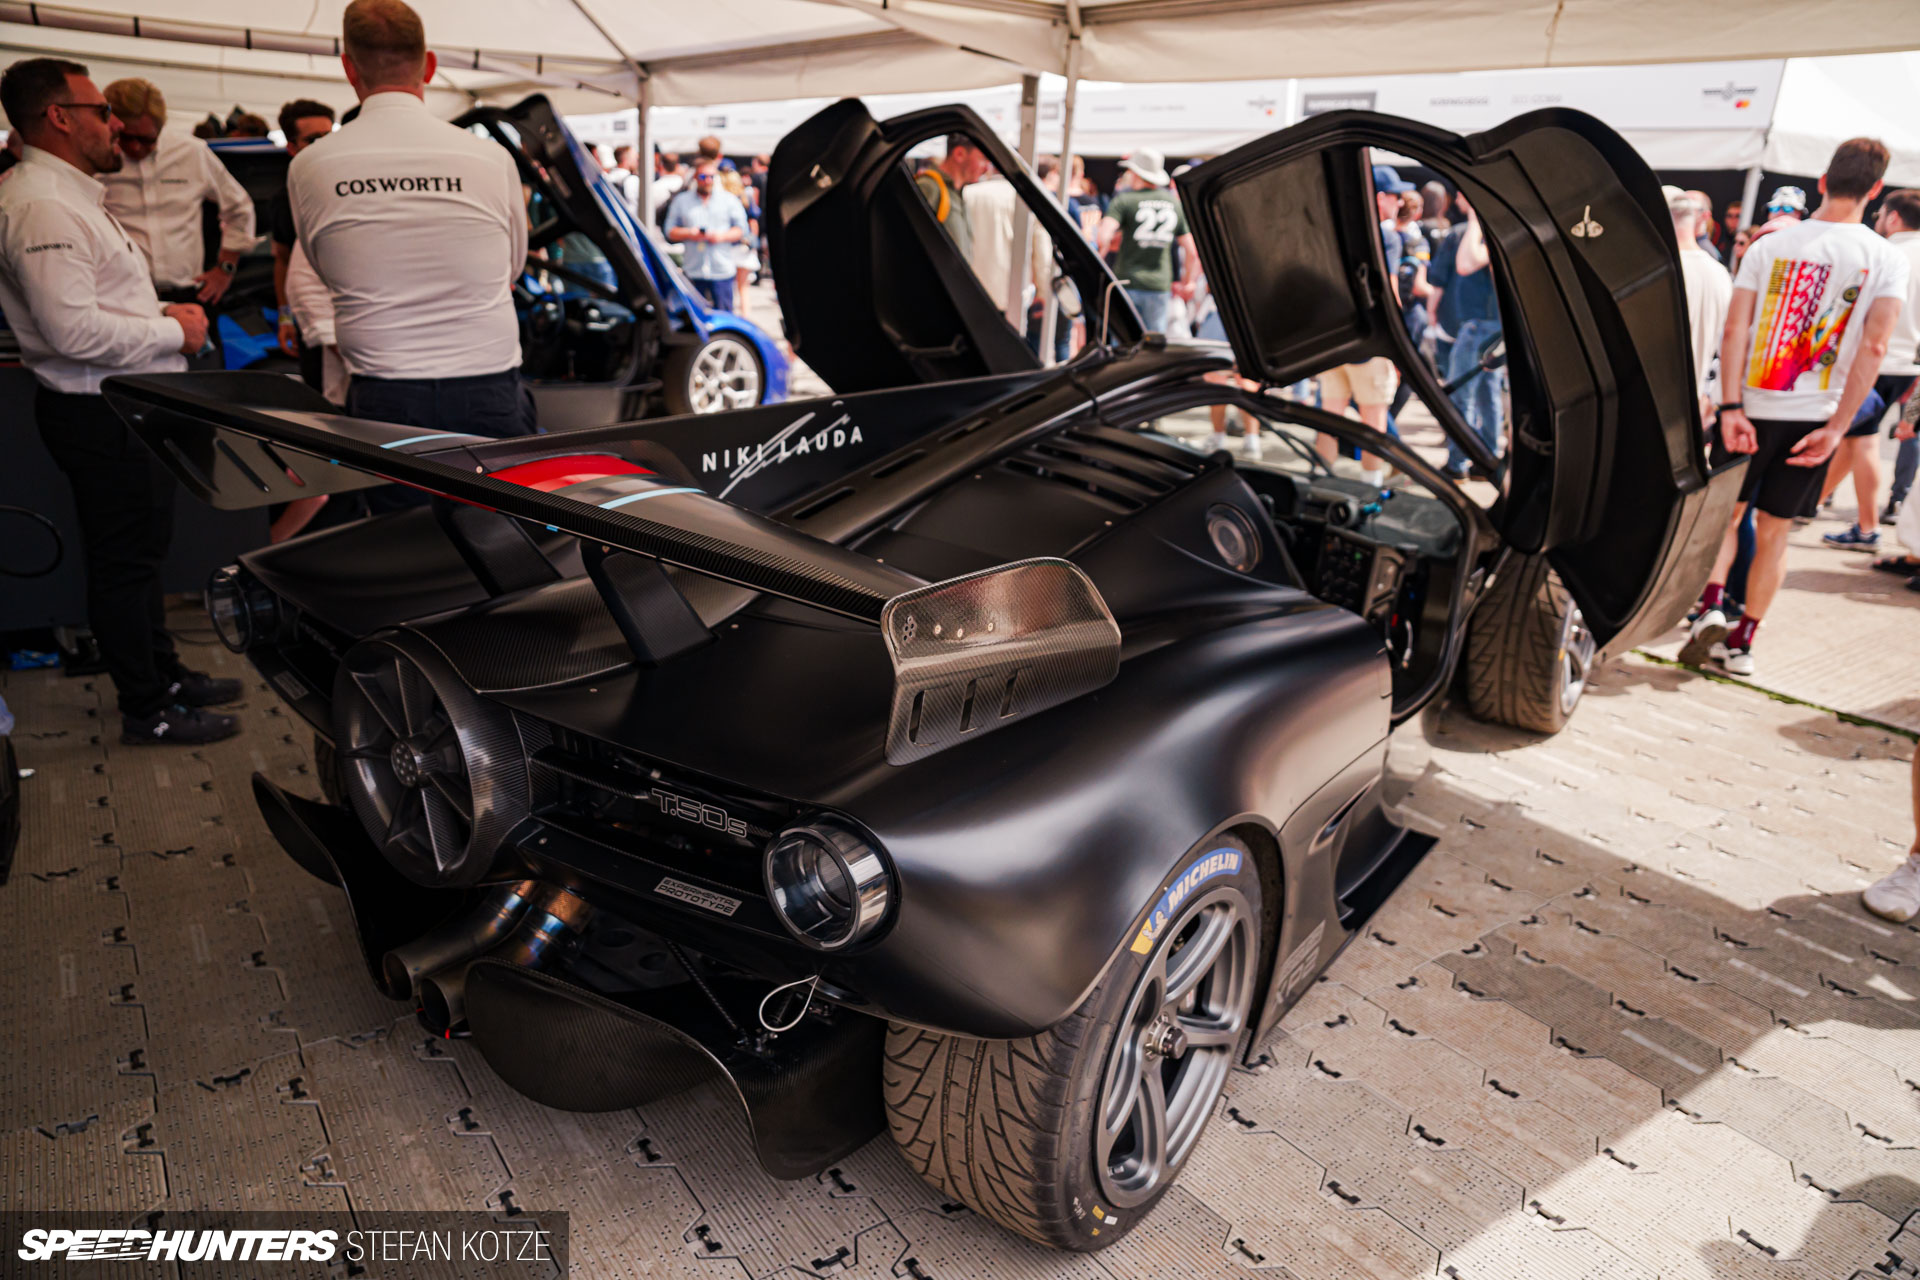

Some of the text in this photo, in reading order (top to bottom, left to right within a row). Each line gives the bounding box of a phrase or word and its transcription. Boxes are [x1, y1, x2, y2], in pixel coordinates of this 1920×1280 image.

[335, 176, 463, 197] COSWORTH
[1133, 208, 1178, 241] 22
[702, 426, 863, 473] NIKI LAUDA
[663, 879, 737, 907] EXPERIMENTAL
[1168, 854, 1240, 909] MICHELIN
[657, 884, 734, 914] PROTOTYPE
